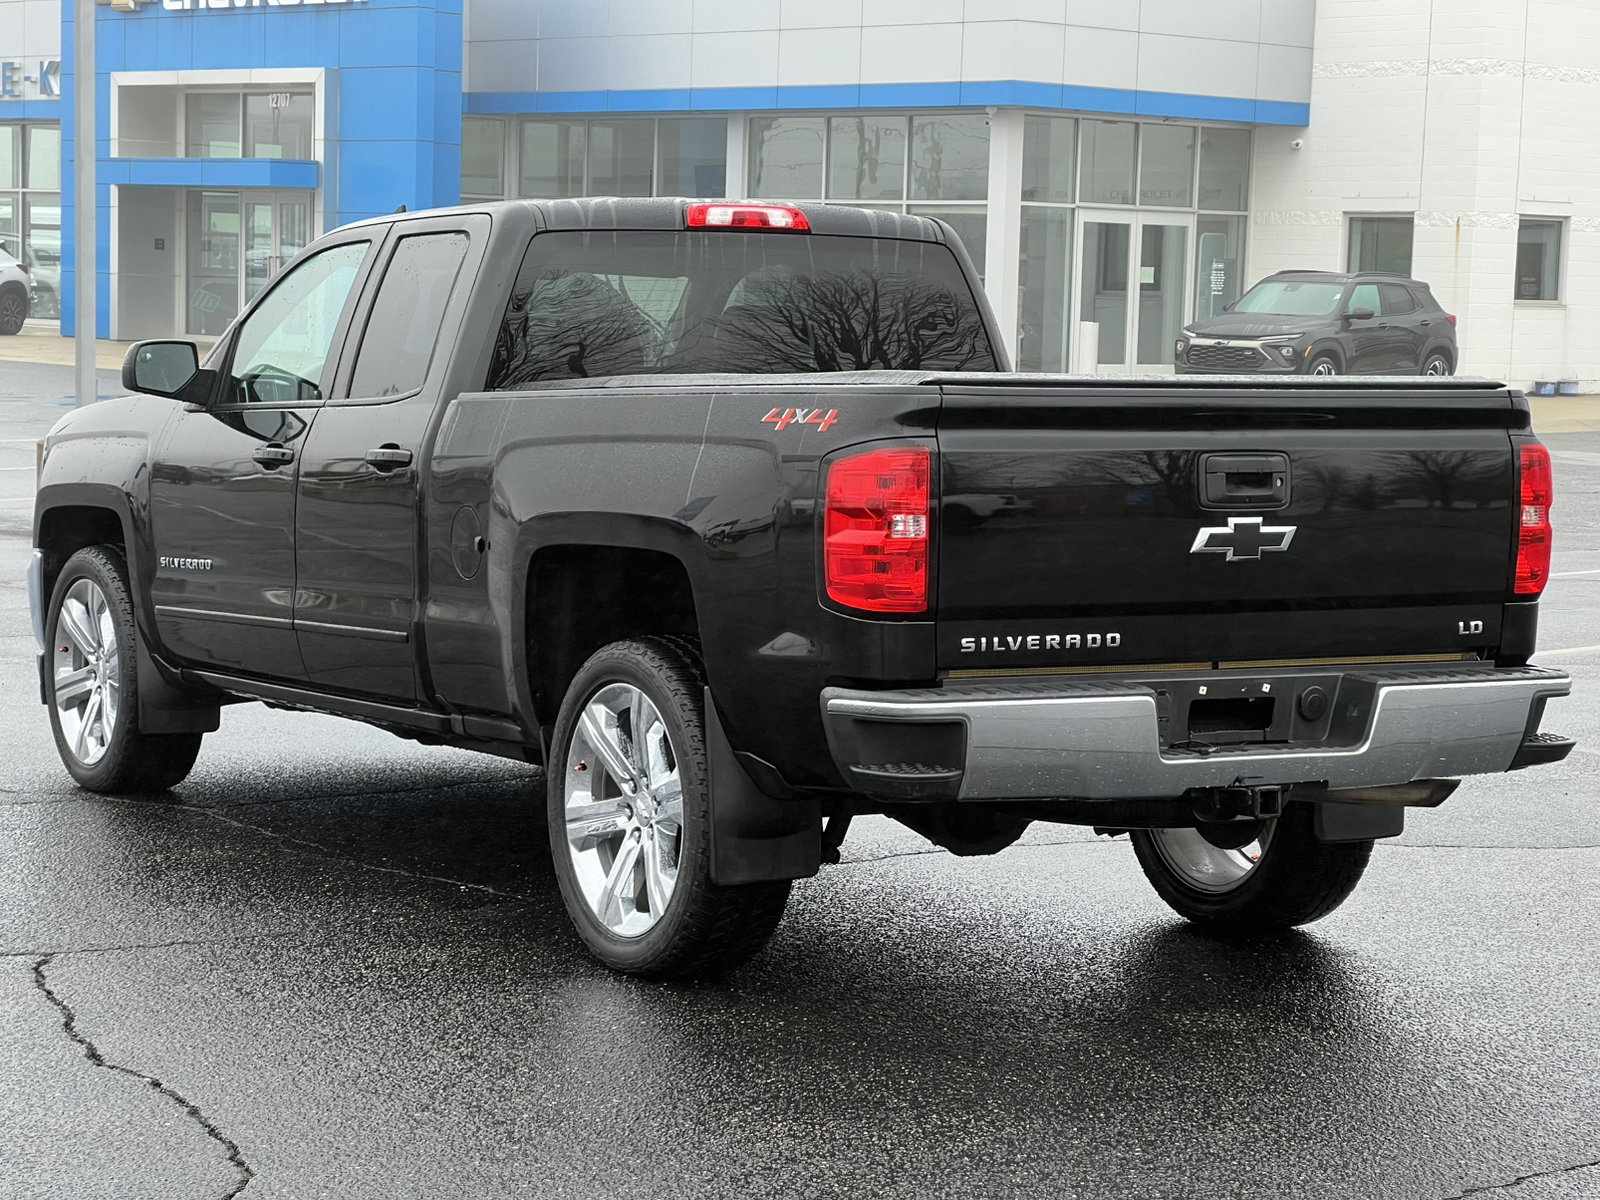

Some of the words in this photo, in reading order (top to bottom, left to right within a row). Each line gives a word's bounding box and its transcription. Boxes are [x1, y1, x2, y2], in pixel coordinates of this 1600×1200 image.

[268, 93, 290, 108] 12707
[1110, 189, 1173, 199] CHEROLET
[160, 556, 213, 570] SILVERADO
[1458, 620, 1483, 635] LD
[960, 632, 1122, 652] SILVERADO
